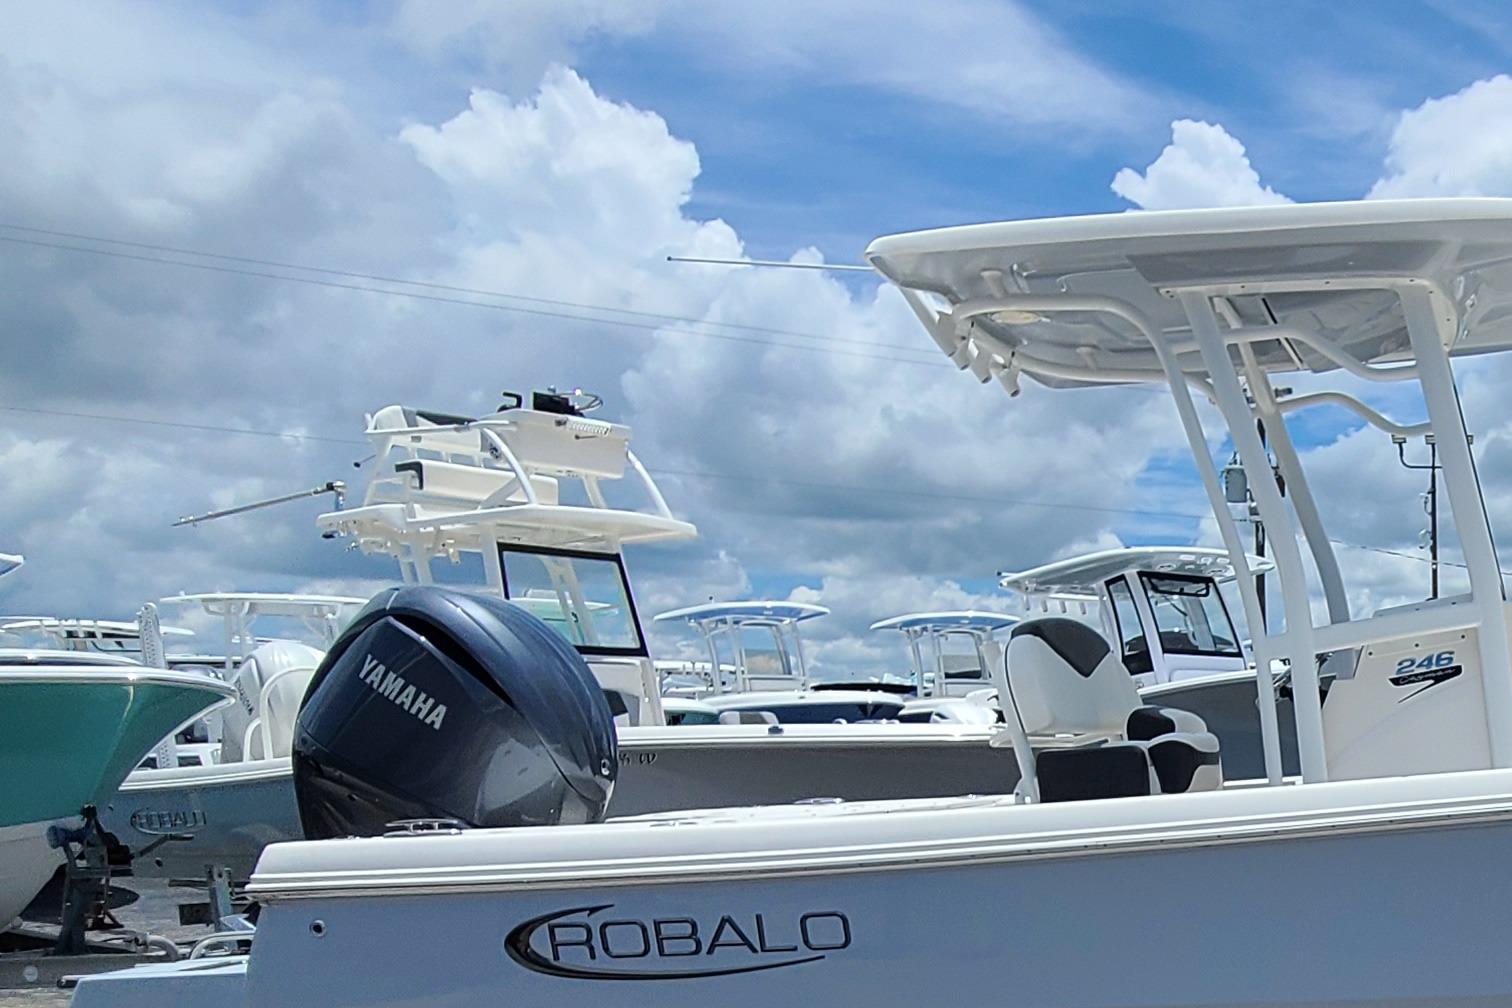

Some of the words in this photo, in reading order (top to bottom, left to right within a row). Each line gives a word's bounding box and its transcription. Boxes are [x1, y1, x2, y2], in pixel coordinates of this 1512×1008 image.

[1396, 651, 1455, 675] 246
[359, 653, 447, 730] YAMAHA
[547, 911, 852, 961] ROBALO
